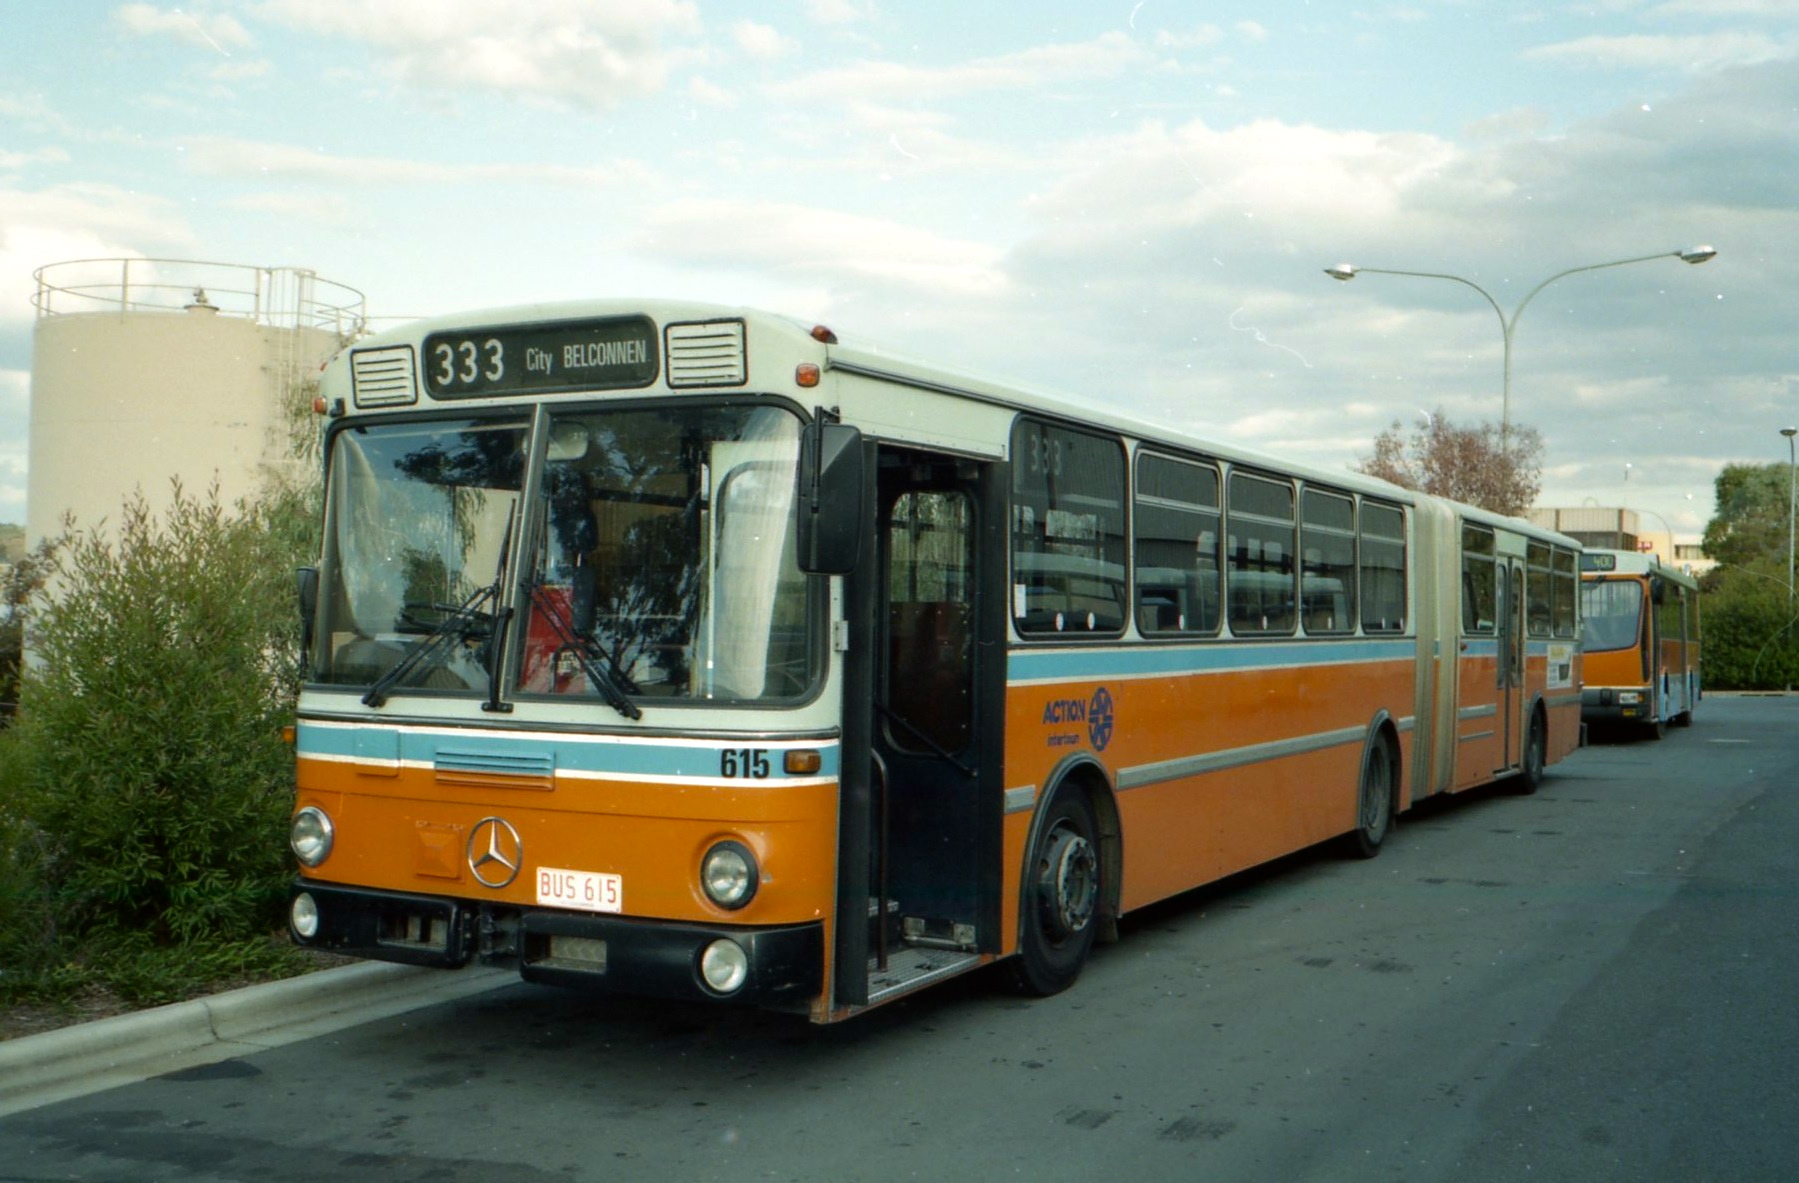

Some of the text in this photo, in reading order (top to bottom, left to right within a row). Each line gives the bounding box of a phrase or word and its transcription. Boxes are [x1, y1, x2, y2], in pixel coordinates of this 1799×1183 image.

[435, 339, 647, 386] 333 City BELCONNEN
[1030, 434, 1062, 476] 333
[1042, 698, 1086, 725] ACTION
[720, 748, 770, 779] 615
[540, 872, 617, 904] BUS 615
